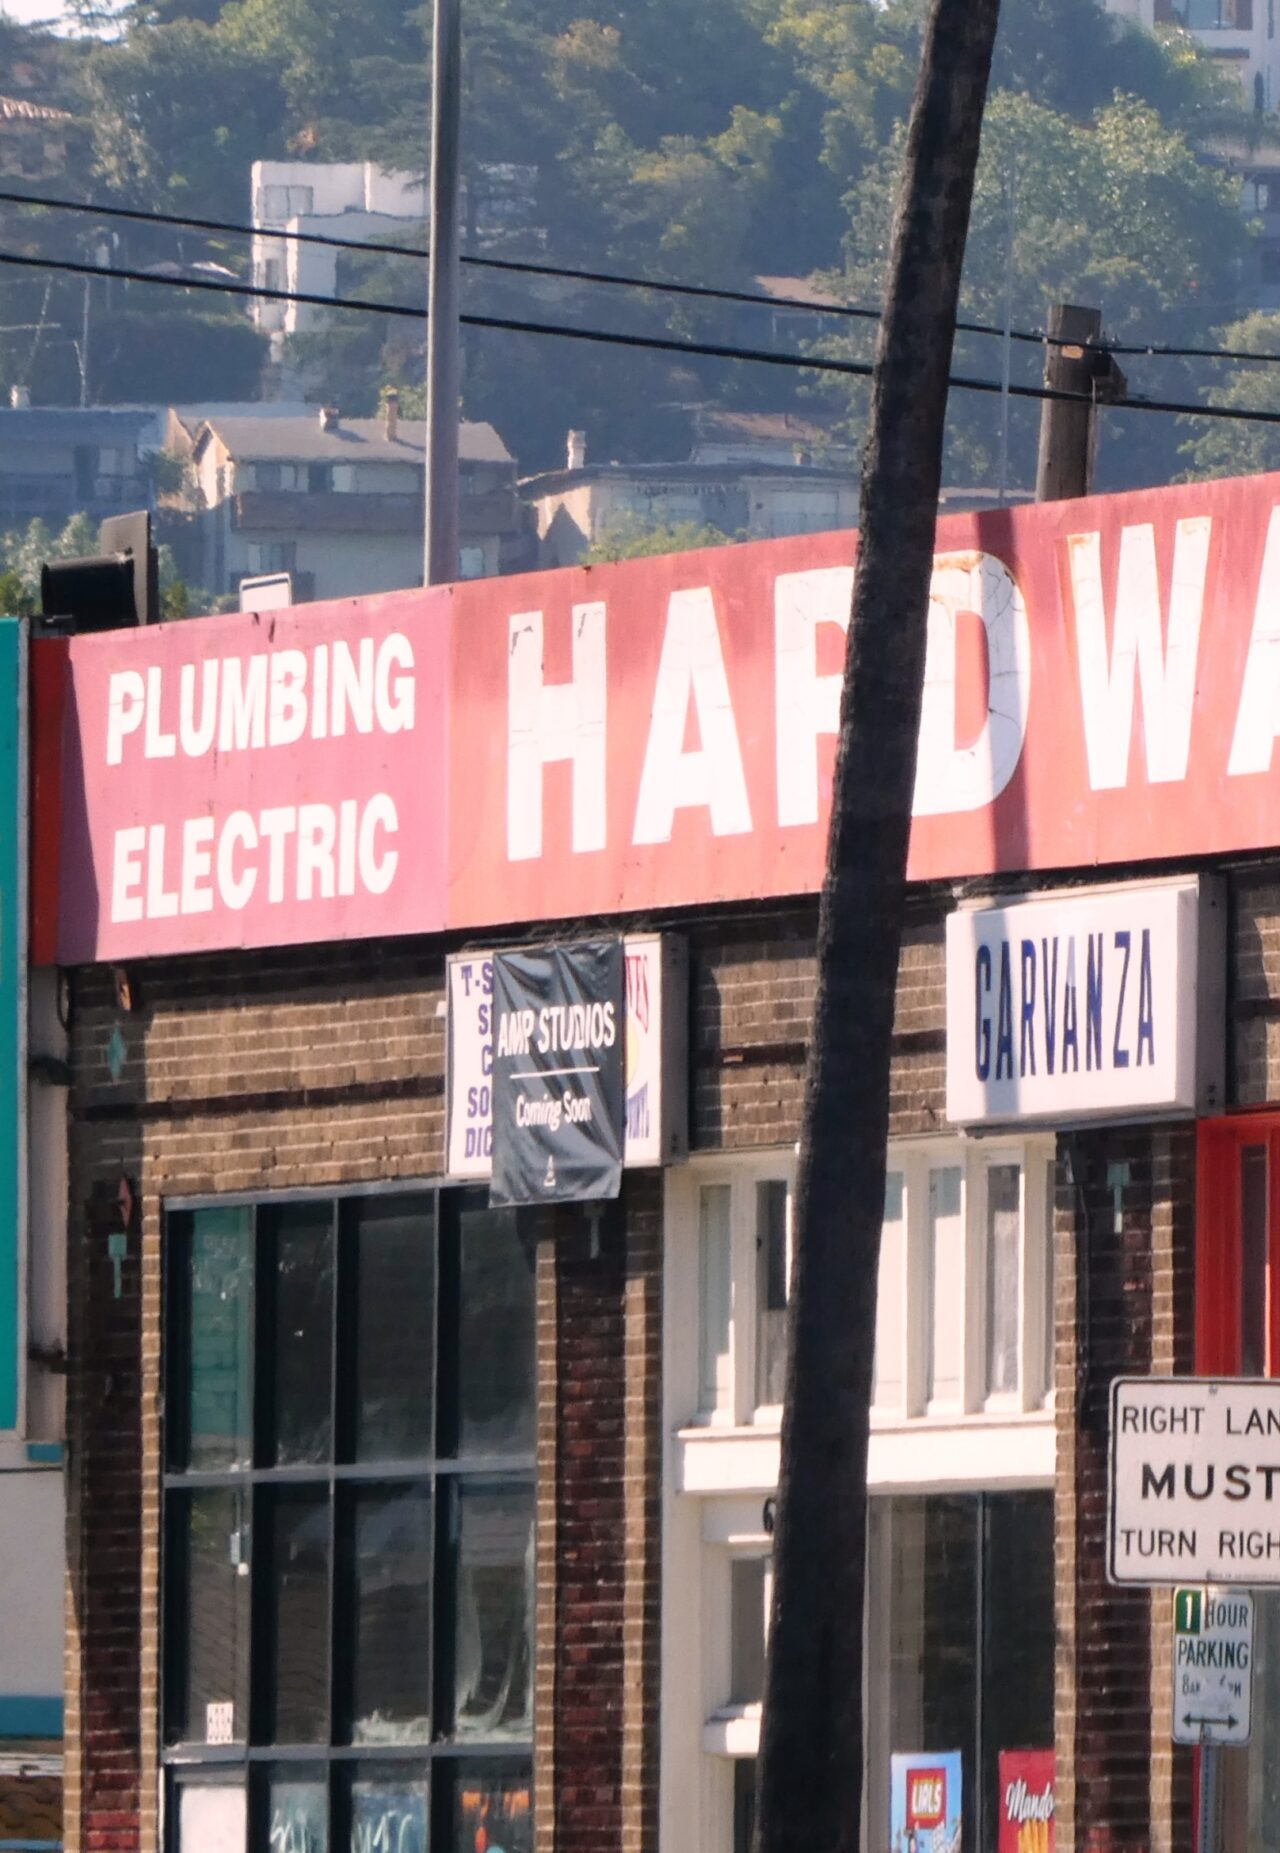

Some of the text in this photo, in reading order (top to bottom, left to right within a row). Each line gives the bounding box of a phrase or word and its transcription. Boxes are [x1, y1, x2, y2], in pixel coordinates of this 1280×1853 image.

[106, 632, 416, 766] PLUMBING
[111, 792, 399, 923] ELECTRIC
[975, 928, 1155, 1082] GARVANZA
[498, 1010, 535, 1058] AMP
[537, 1001, 616, 1054] STUDIOS
[516, 1093, 562, 1132] Coming
[563, 1091, 591, 1123] Soon
[1122, 1406, 1205, 1435] RIGHT
[1121, 1529, 1197, 1558] TURN
[1185, 1593, 1249, 1630] 1 HOUR
[1178, 1638, 1249, 1669] PARKING
